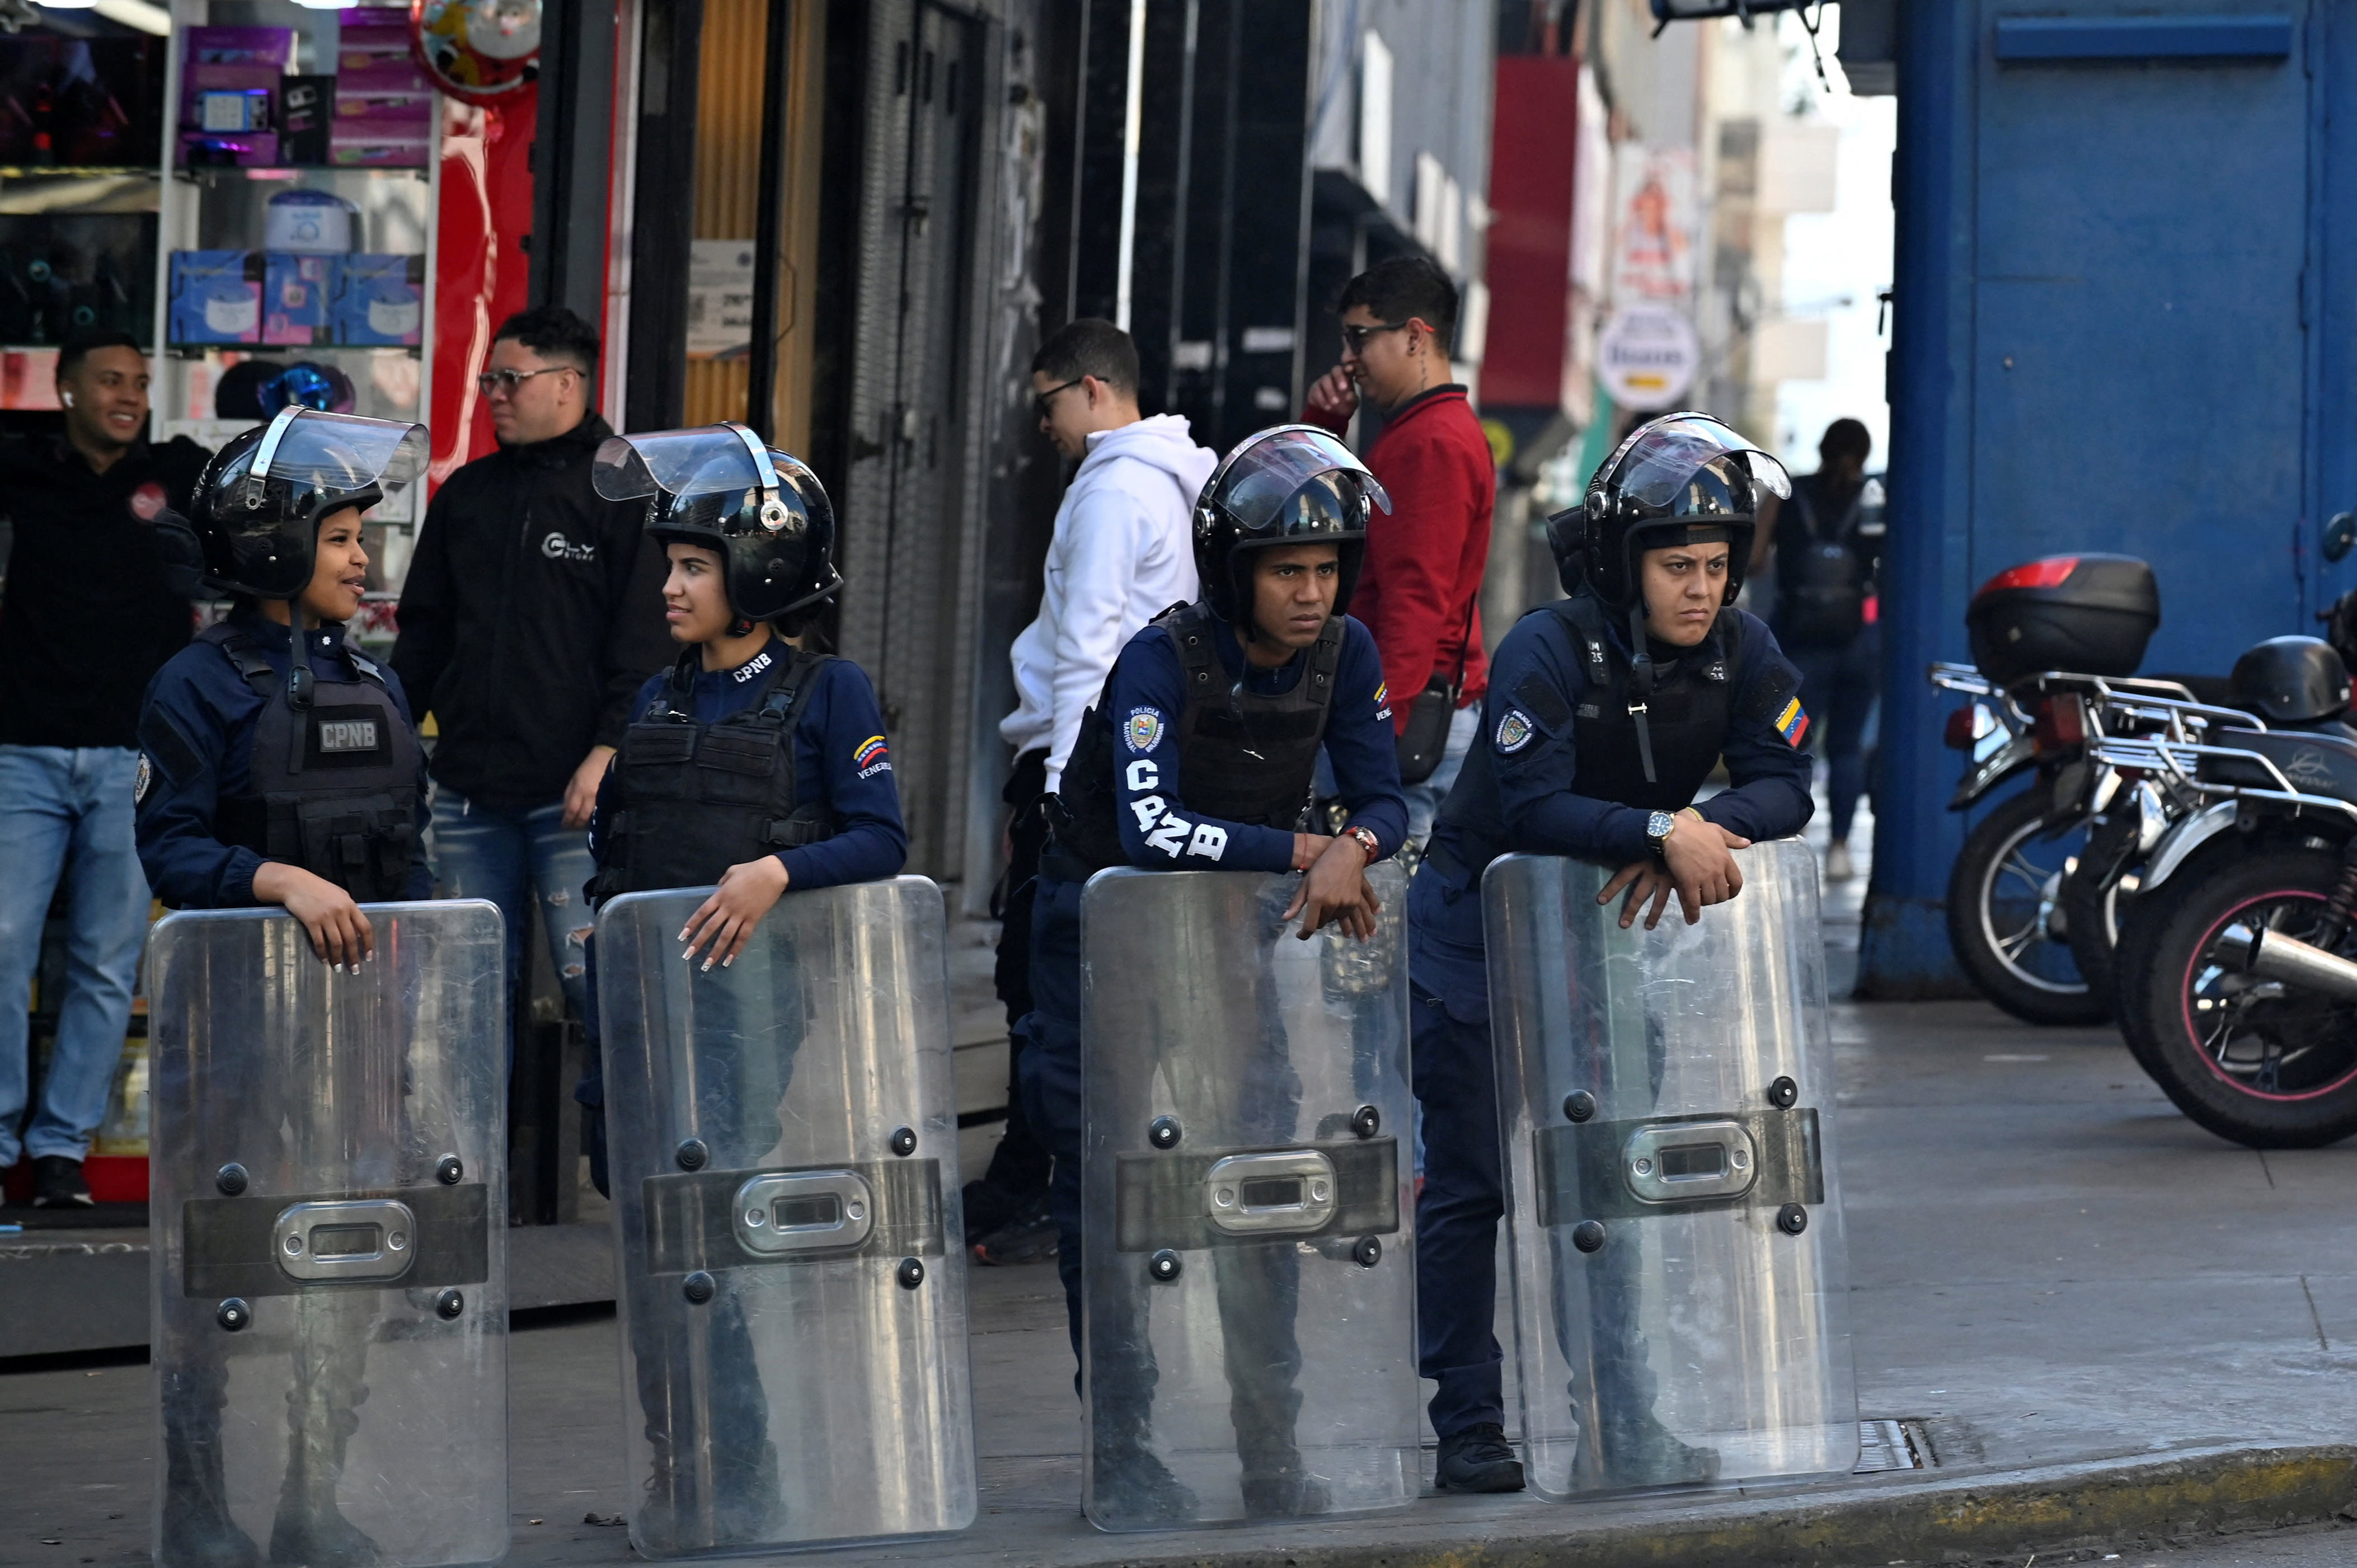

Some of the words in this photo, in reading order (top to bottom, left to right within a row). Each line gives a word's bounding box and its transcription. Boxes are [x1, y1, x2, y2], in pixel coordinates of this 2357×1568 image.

[733, 652, 772, 683] CPNB
[1130, 707, 1159, 717] POLICIA
[1513, 710, 1532, 729] POLICIA
[323, 724, 375, 748] CPNB
[1126, 759, 1229, 862] CPNB
